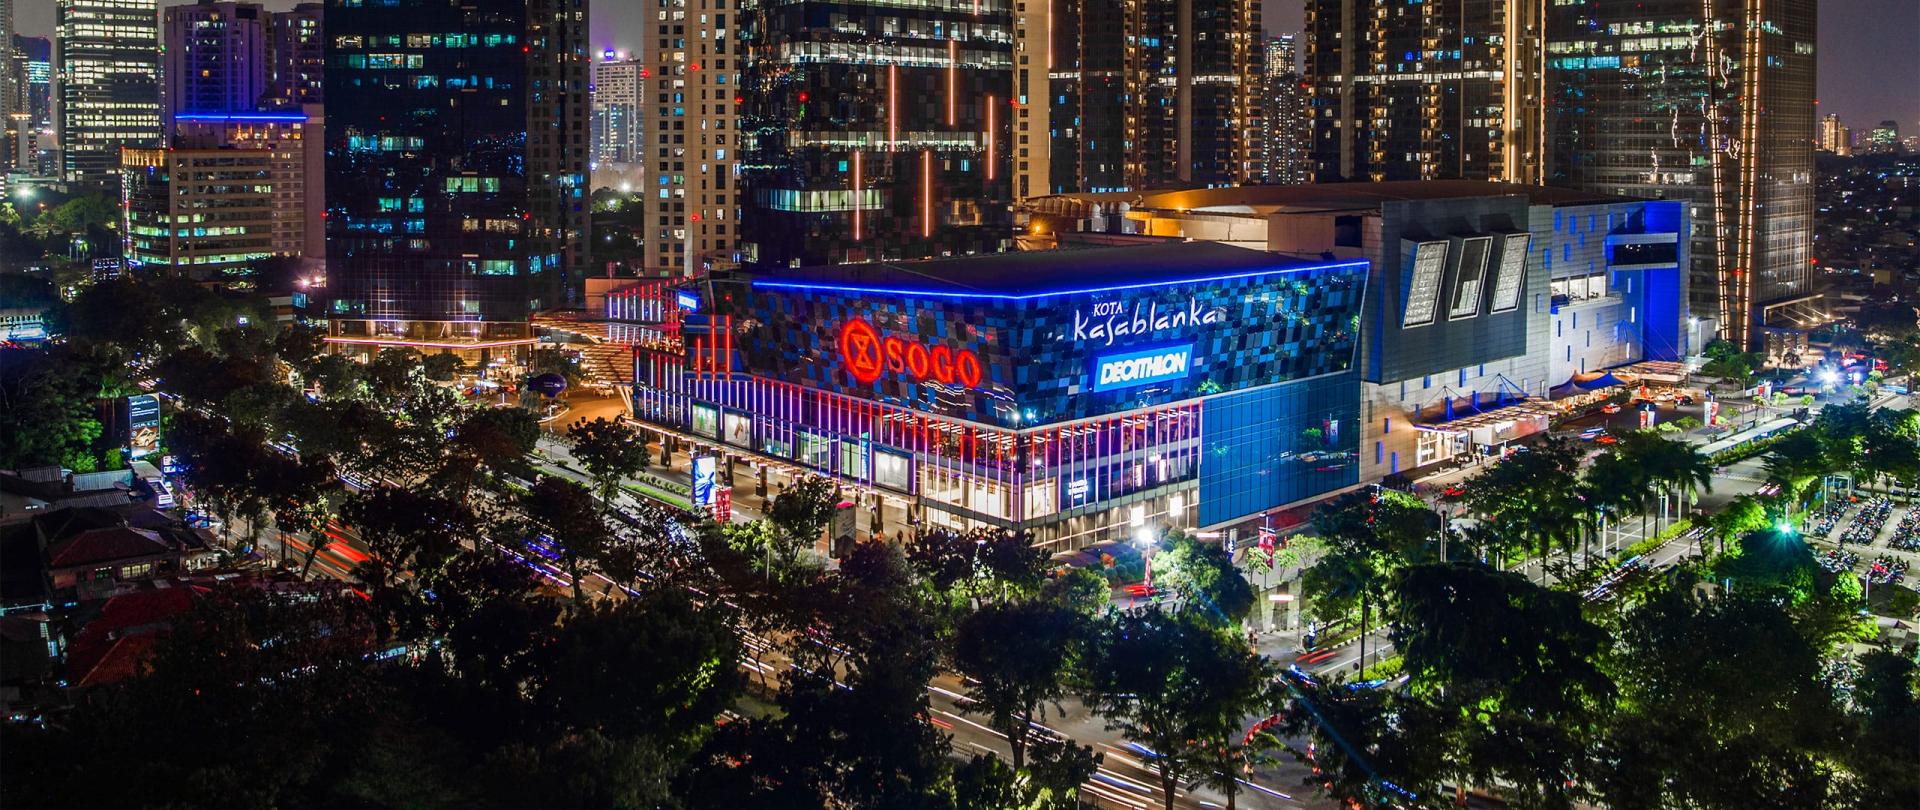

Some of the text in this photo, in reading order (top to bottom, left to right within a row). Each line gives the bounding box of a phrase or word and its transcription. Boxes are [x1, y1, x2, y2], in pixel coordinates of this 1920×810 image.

[1093, 301, 1123, 317] KOTA
[884, 337, 982, 388] SOGO
[1100, 352, 1187, 385] DECATHLON
